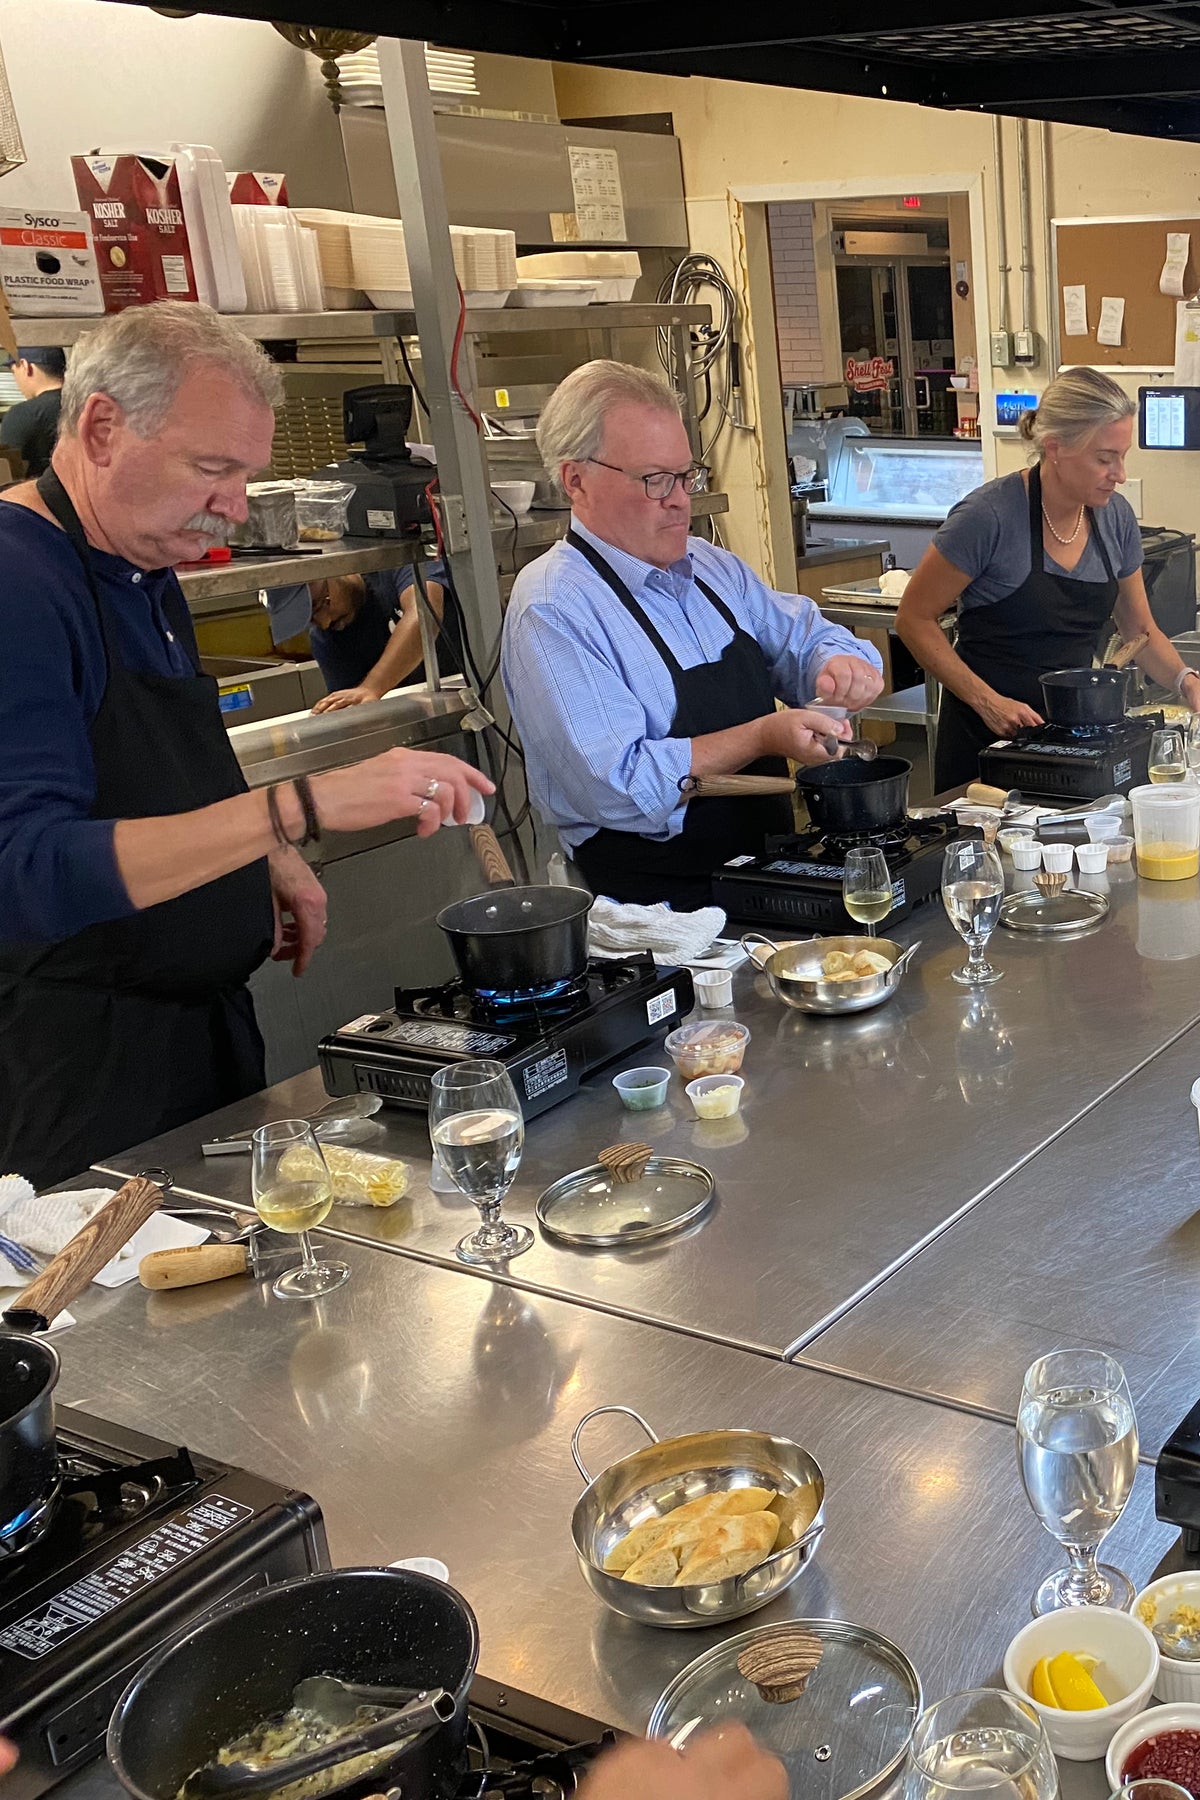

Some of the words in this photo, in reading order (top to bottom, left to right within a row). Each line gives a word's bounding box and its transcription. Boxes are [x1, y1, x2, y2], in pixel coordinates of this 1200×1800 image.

[92, 203, 126, 219] KOSHER
[146, 208, 183, 225] KOSHER
[24, 213, 60, 228] Sysco
[103, 219, 119, 228] SALT
[159, 225, 175, 233] SALT
[21, 230, 67, 247] Classic
[4, 275, 39, 284] PLASTIC
[41, 277, 64, 286] FOOD
[65, 278, 90, 287] WRAP
[847, 360, 871, 380] Shell
